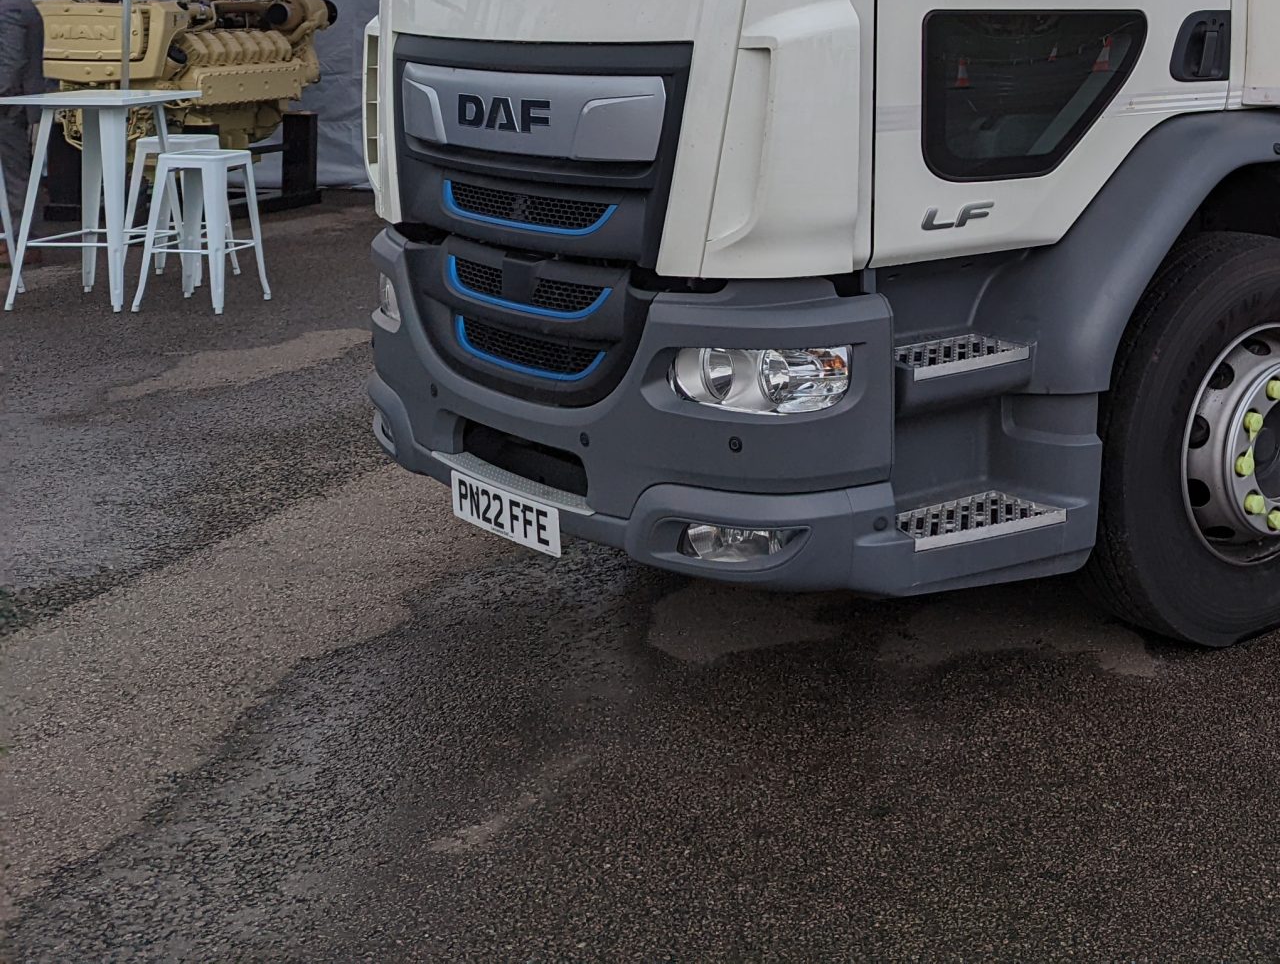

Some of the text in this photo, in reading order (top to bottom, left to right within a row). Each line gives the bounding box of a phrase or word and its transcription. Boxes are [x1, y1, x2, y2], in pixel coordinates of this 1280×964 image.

[50, 24, 118, 41] MAN
[457, 93, 551, 133] DAF
[921, 201, 995, 231] LF
[458, 478, 550, 547] PN22 FFE
